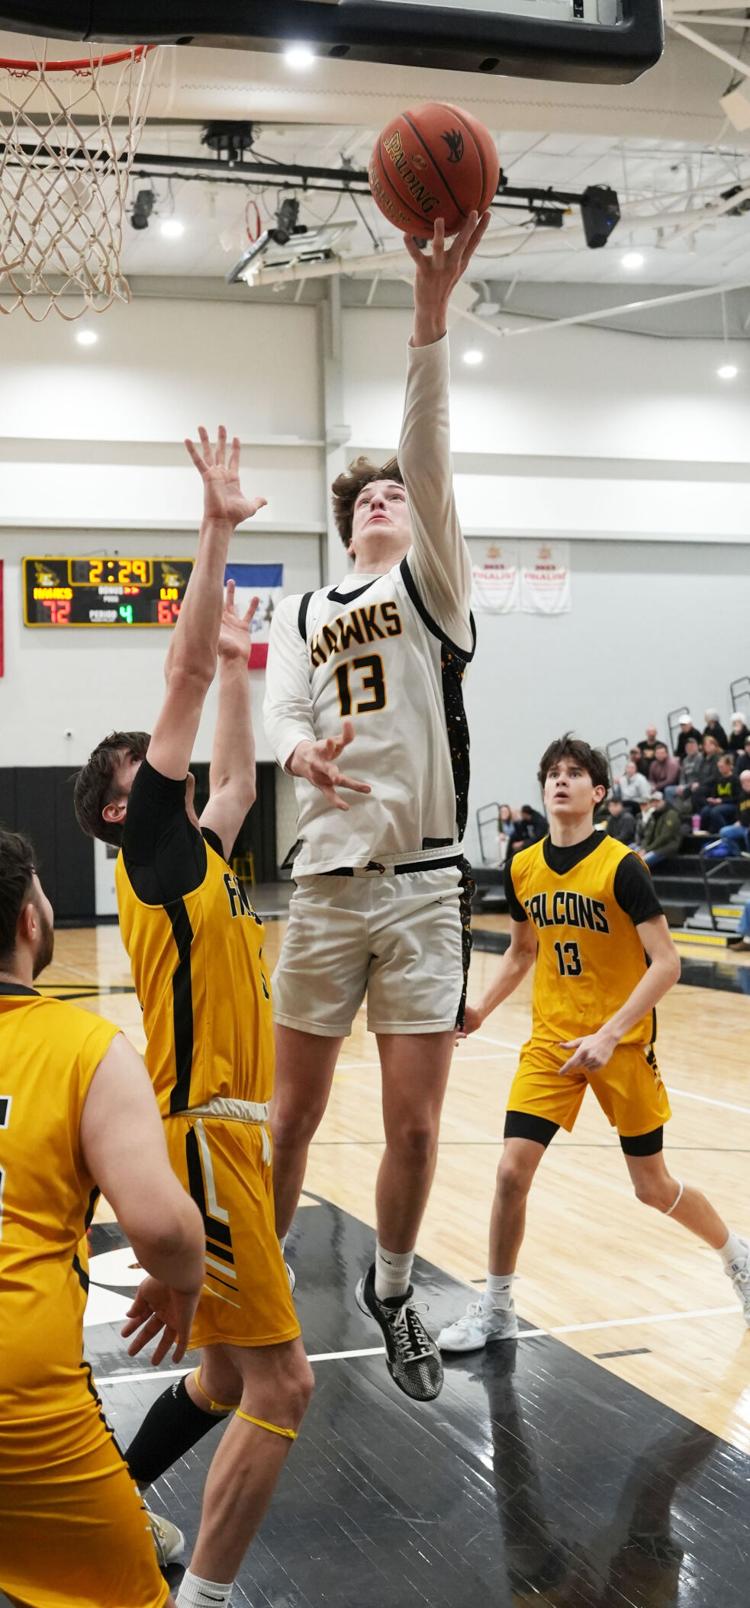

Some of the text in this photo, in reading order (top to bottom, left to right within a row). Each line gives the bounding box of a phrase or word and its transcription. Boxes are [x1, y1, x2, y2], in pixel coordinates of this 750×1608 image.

[383, 130, 440, 213] SPALDING
[88, 560, 147, 583] 2:29
[43, 600, 71, 624] 72
[119, 605, 132, 624] 4
[310, 600, 402, 668] HAWKS
[334, 653, 387, 717] 13
[554, 941, 583, 977] 13
